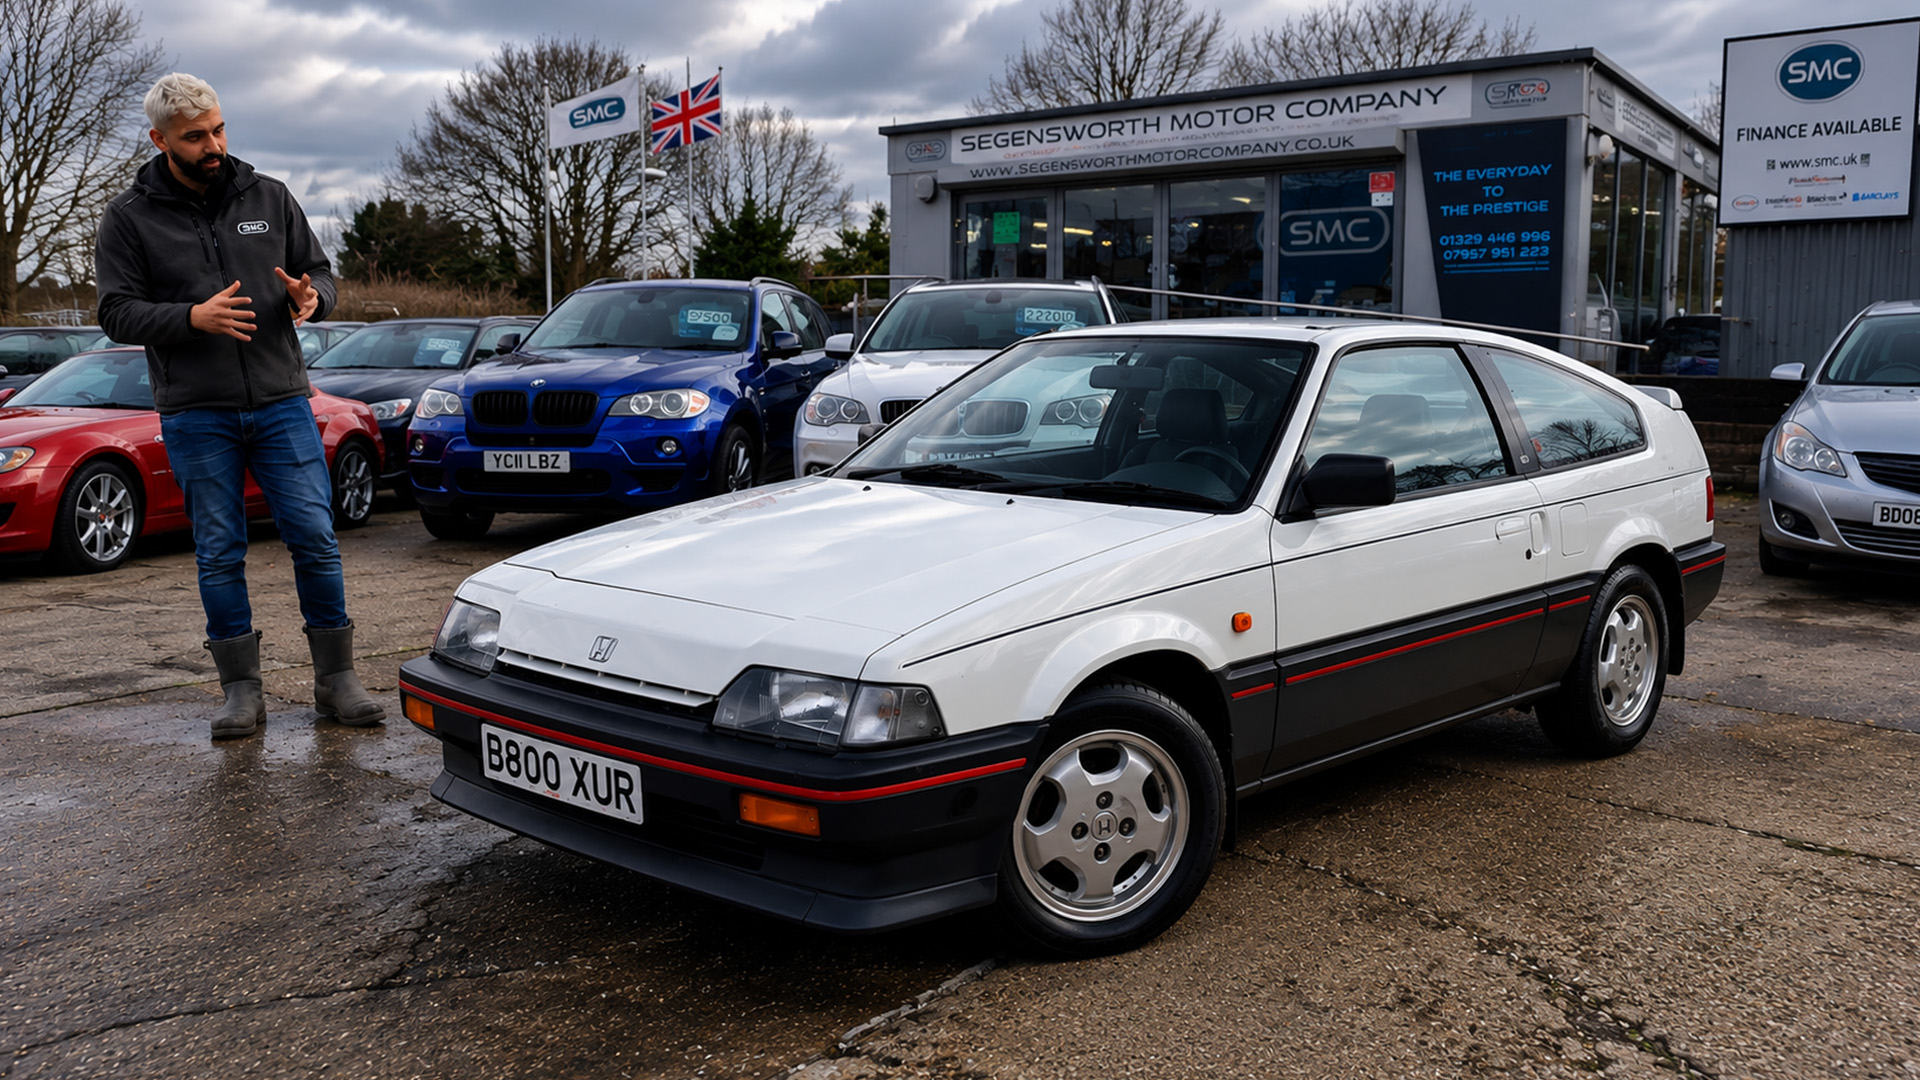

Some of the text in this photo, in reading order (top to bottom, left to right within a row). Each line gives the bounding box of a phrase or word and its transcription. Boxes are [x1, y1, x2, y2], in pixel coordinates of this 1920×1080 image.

[1787, 57, 1853, 84] SMC
[572, 100, 619, 126] SMC
[960, 117, 1161, 152] SEGENSWORTH
[1170, 104, 1275, 131] MOTOR
[1285, 85, 1448, 120] COMPANY
[1736, 116, 1902, 142] FINANCE AVAILABLE
[1780, 153, 1858, 170] www.smc.uk
[1433, 164, 1552, 182] THE EVERYDAY
[1482, 185, 1504, 198] TO
[1440, 200, 1549, 217] THE PRESTIGE
[1289, 217, 1370, 246] SMC
[1440, 233, 1483, 246] 01329
[1520, 230, 1551, 243] 996
[1443, 246, 1550, 260] 07957 951 223
[527, 453, 561, 469] LBZ
[486, 732, 637, 815] B800 XUR
